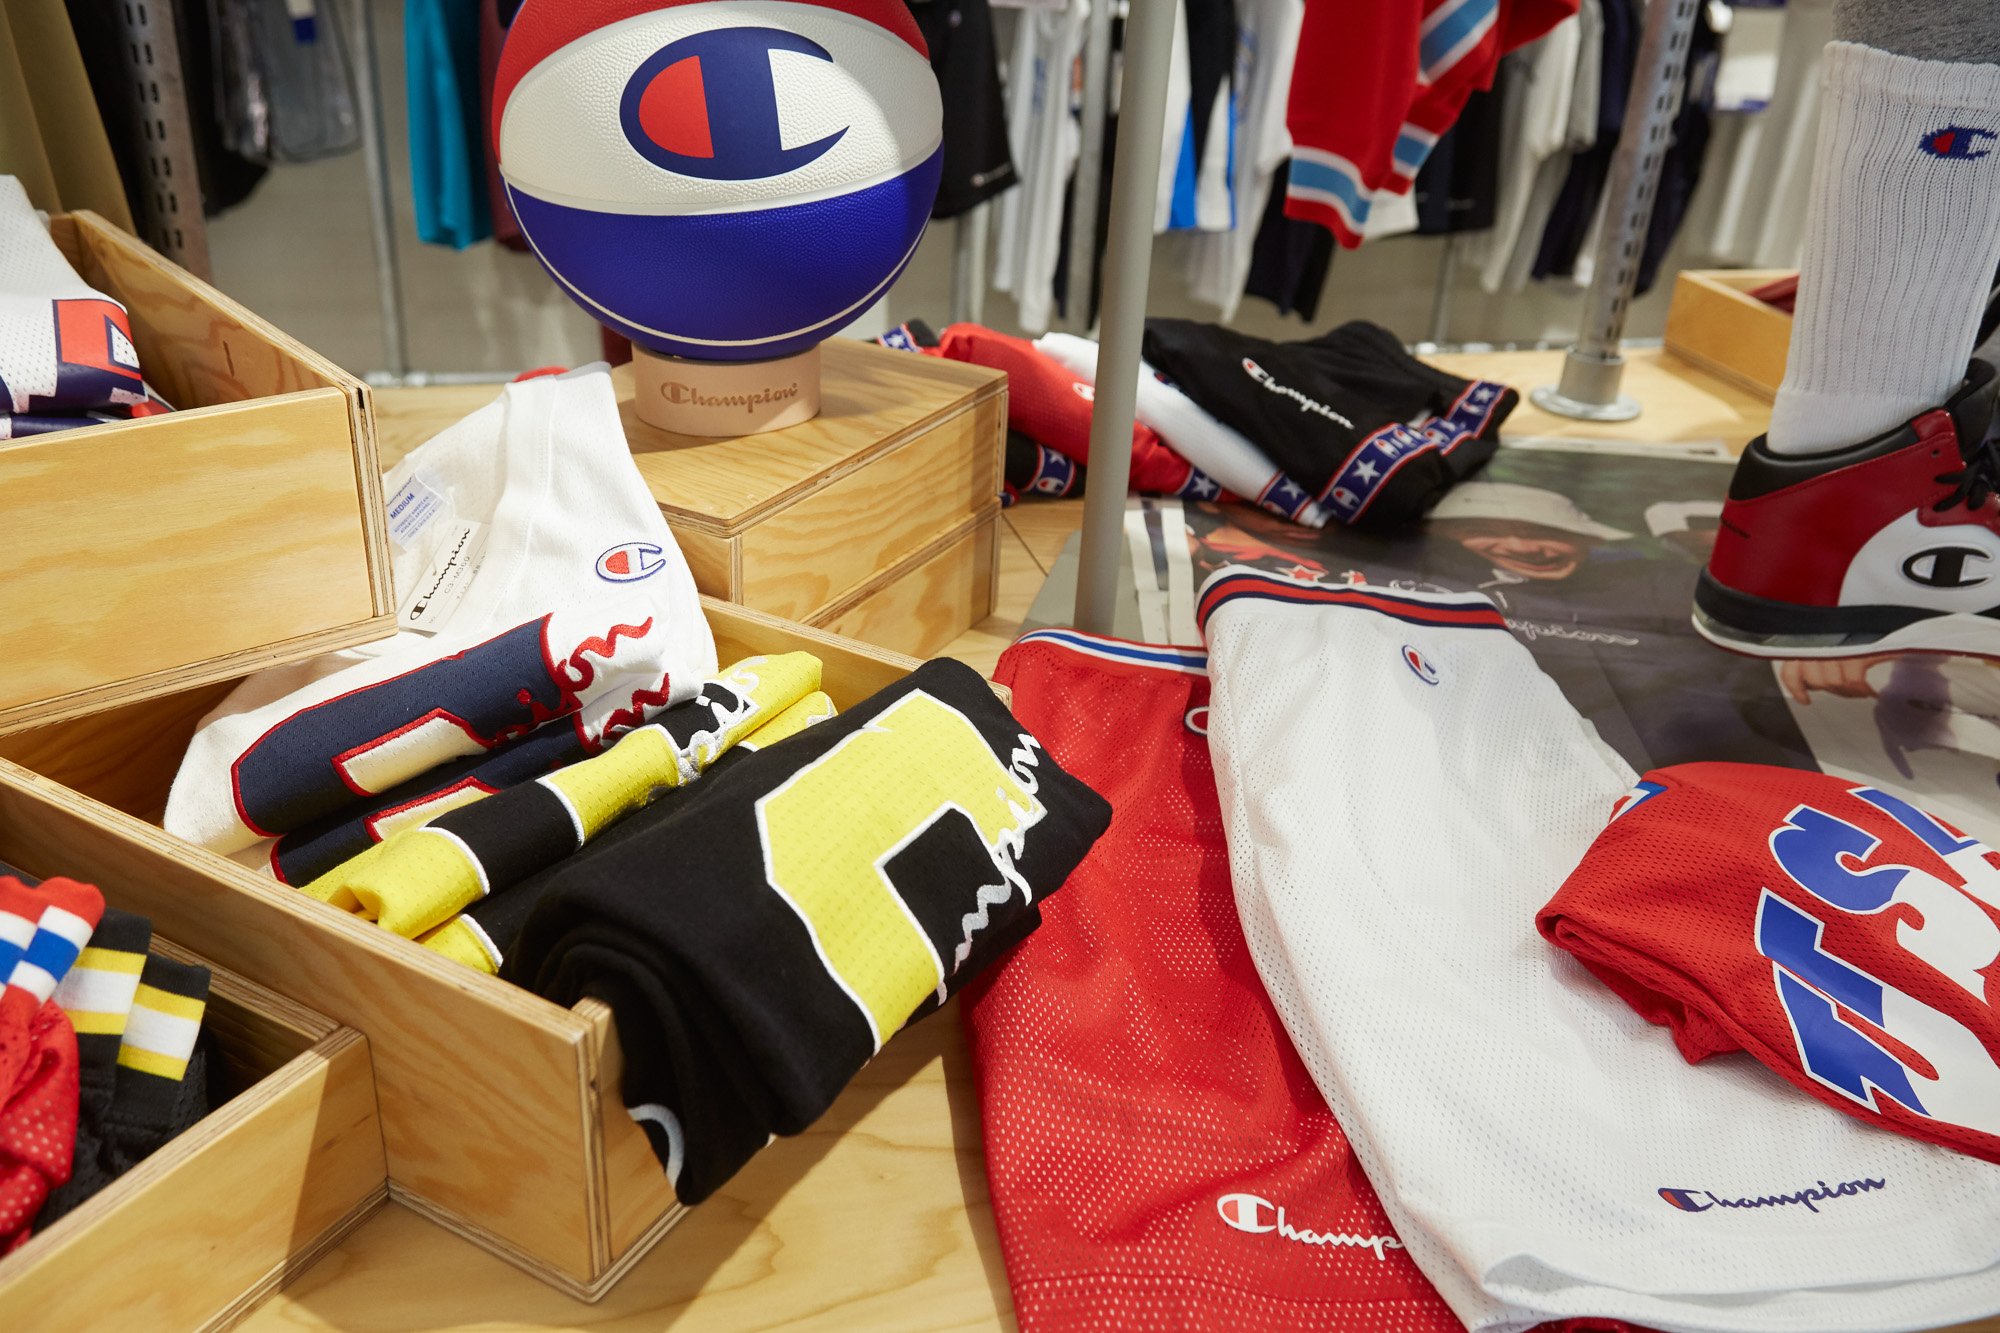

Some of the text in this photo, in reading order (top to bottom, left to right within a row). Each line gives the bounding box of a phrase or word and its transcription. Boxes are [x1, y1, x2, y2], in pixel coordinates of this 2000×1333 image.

[660, 381, 798, 413] Champion
[1242, 357, 1355, 430] Champion
[390, 492, 415, 519] MEDIUM
[410, 528, 470, 620] Champion
[1657, 1178, 1886, 1213] Champion
[1217, 1193, 1405, 1261] Champ
